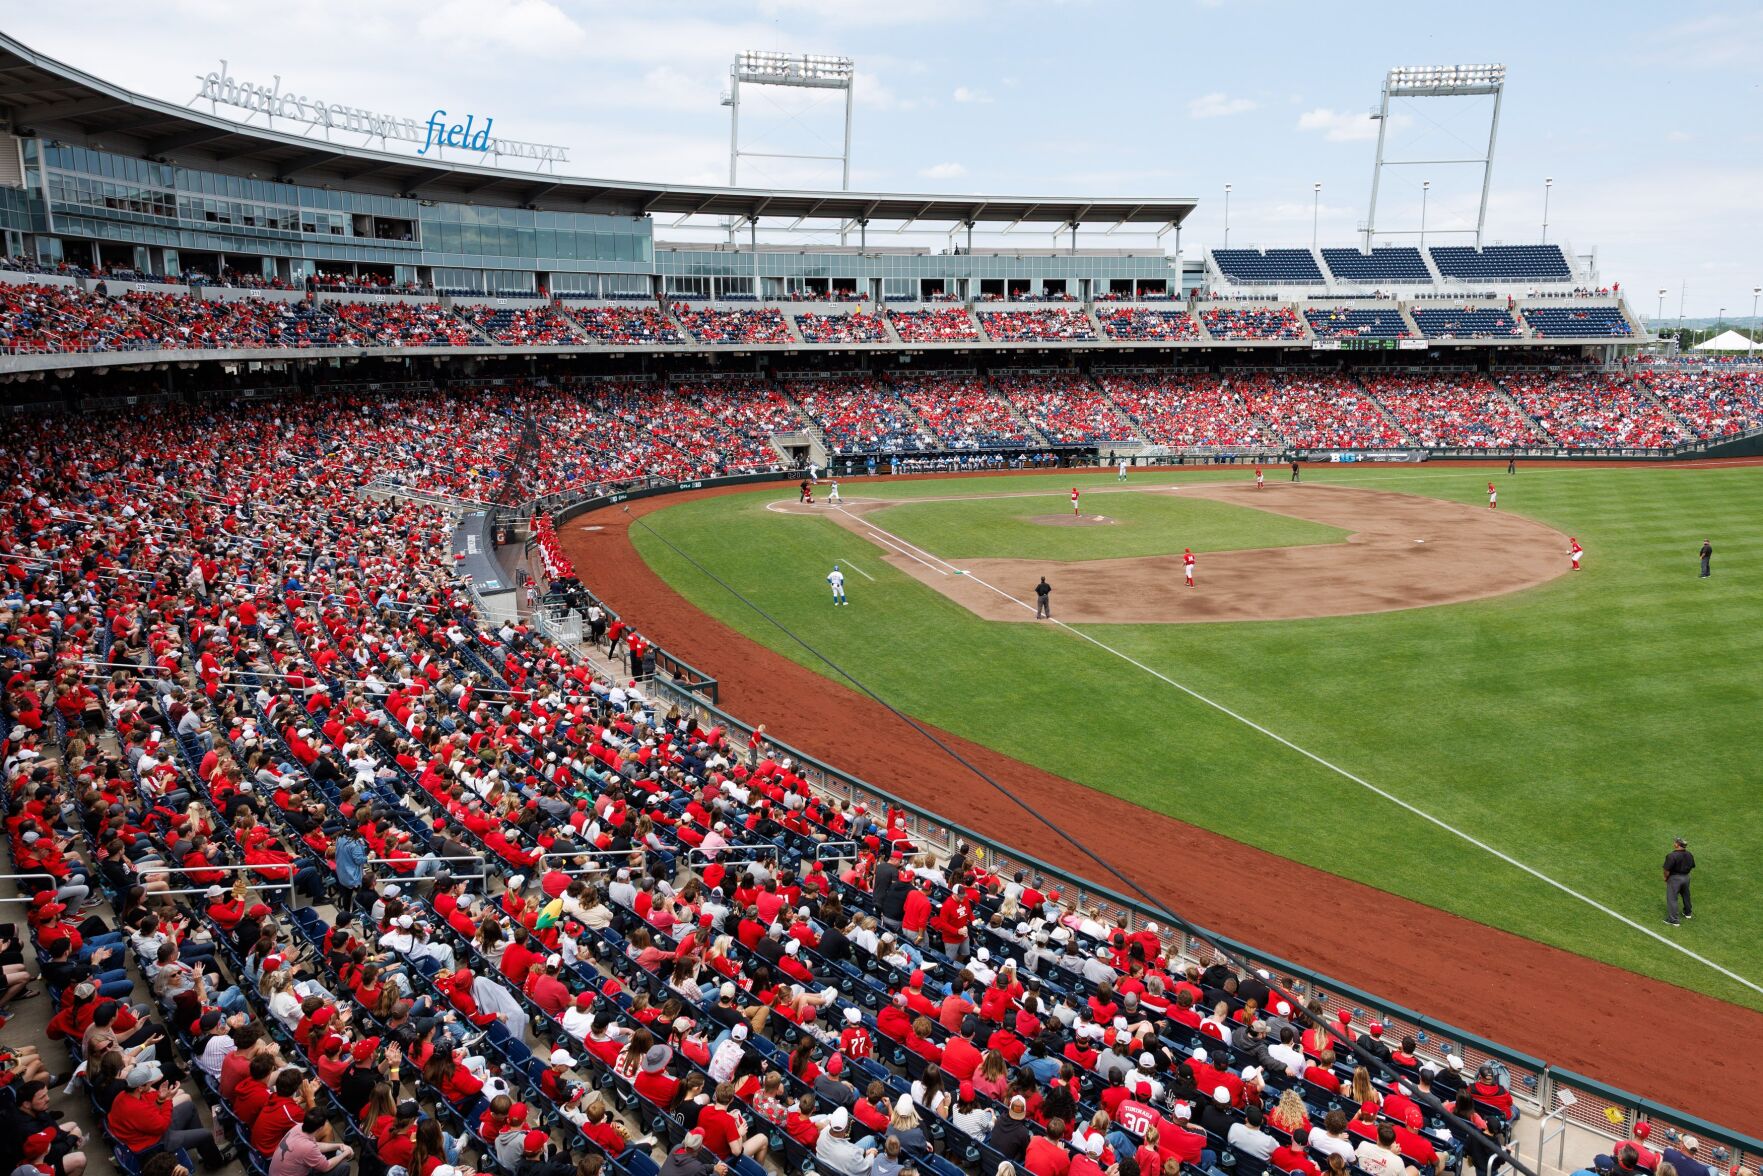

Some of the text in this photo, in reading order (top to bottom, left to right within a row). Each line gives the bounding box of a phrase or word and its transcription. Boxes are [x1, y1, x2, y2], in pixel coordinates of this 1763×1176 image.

[203, 60, 566, 162] charles SCHWAB field OMAHA
[851, 1036, 866, 1055] 77
[1123, 1112, 1150, 1137] 30
